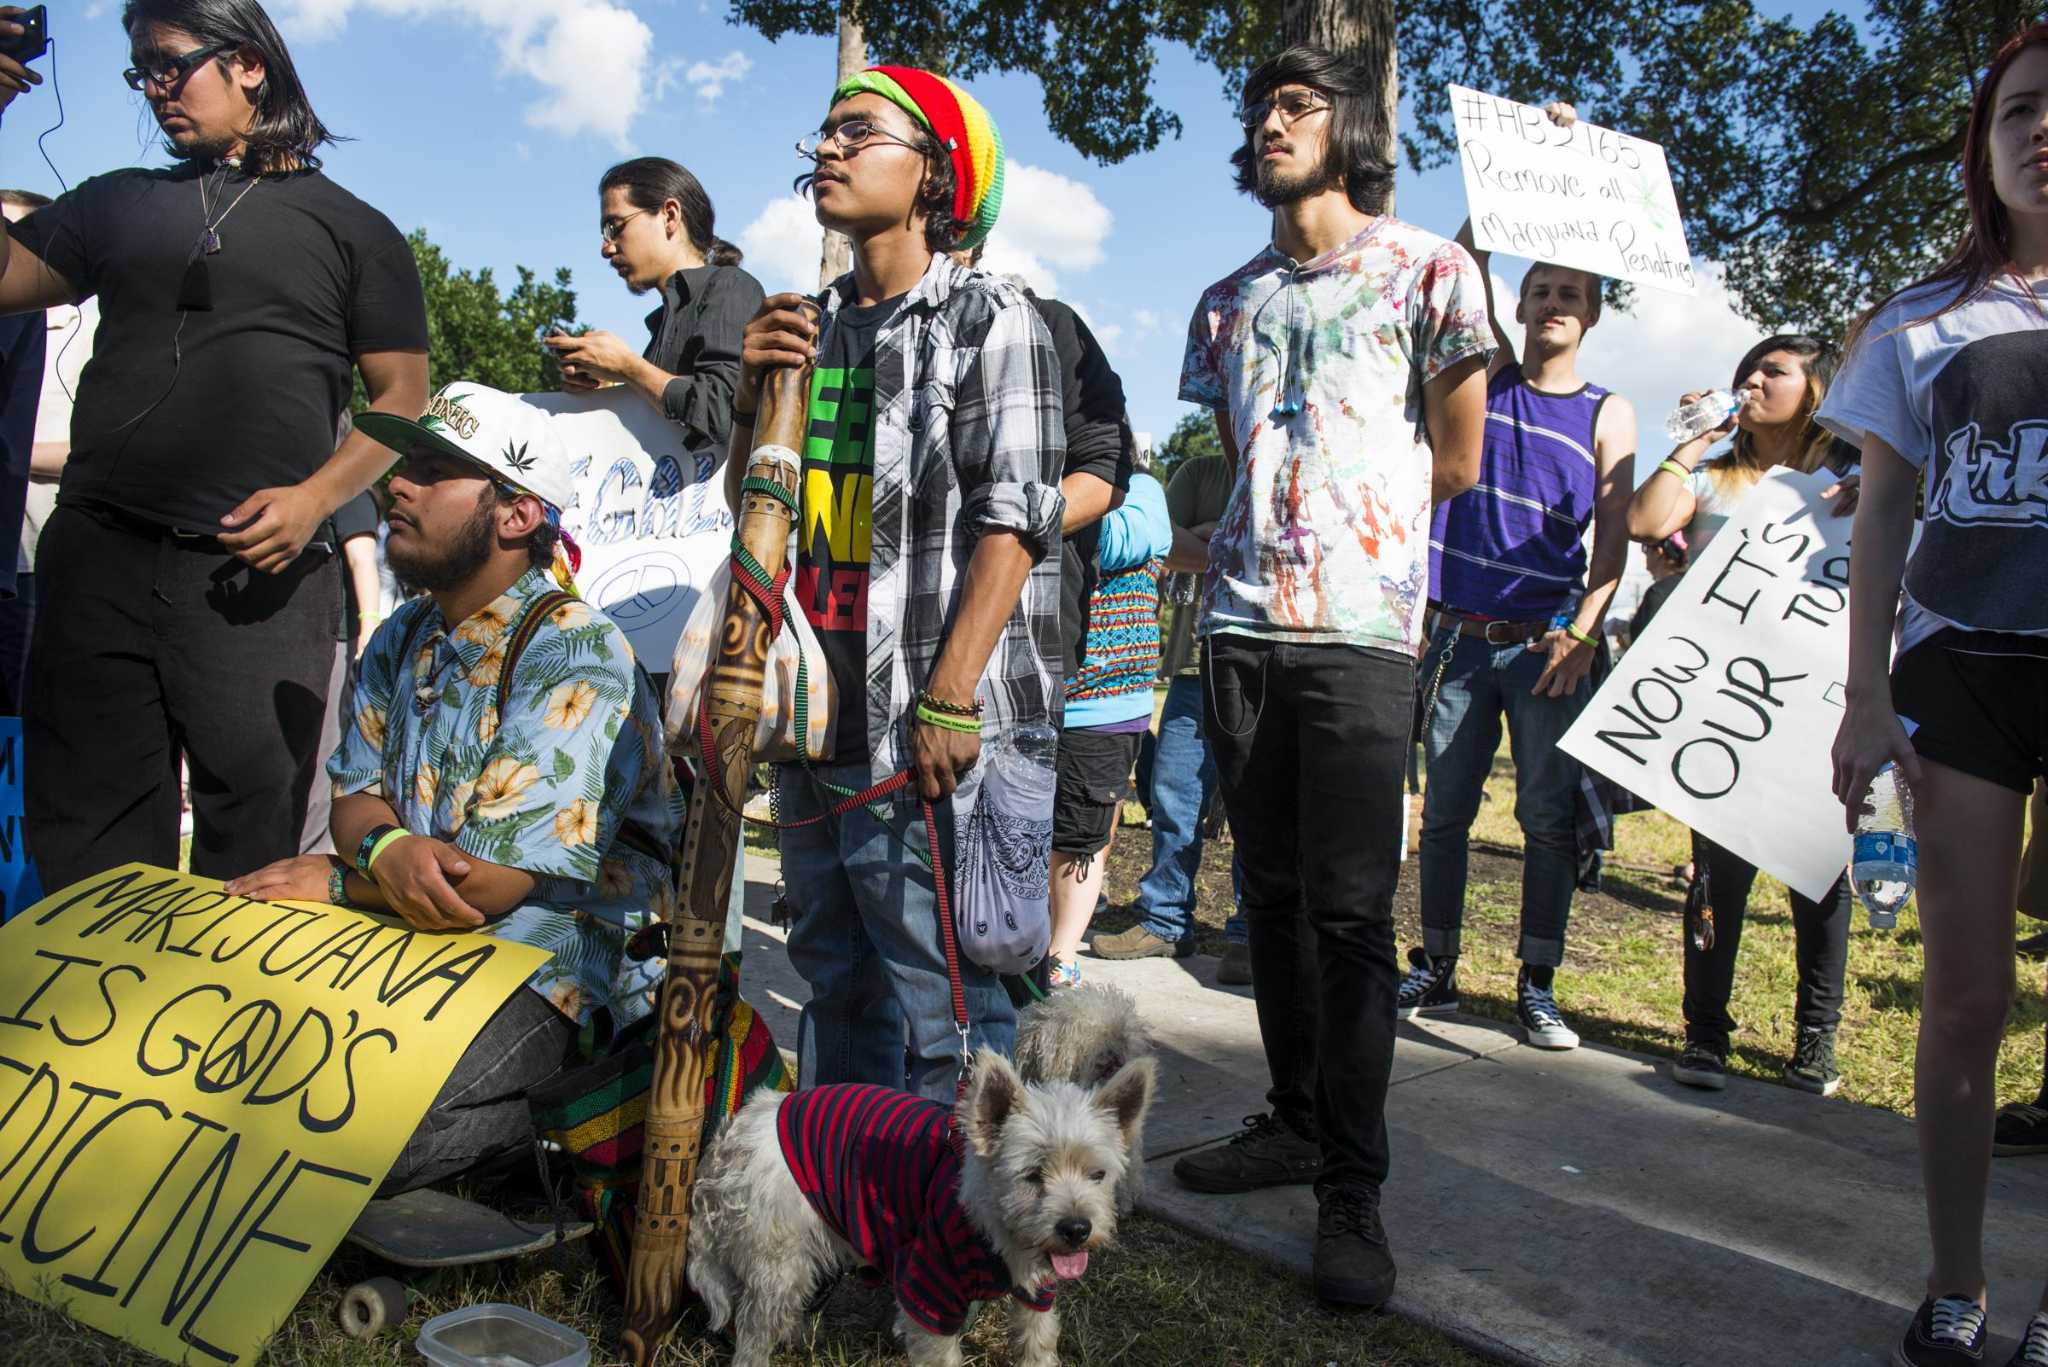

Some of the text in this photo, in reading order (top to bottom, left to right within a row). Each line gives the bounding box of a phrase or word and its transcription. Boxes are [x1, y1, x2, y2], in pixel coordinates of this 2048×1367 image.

[1461, 95, 1641, 170] #HB2165
[1464, 139, 1625, 202] Remove all
[1594, 523, 1810, 766] NOW IT'S
[1671, 656, 1809, 800] OUR
[0, 949, 147, 1046] IS
[35, 871, 497, 1021] MARIJUANA
[0, 1056, 373, 1363] DICINE
